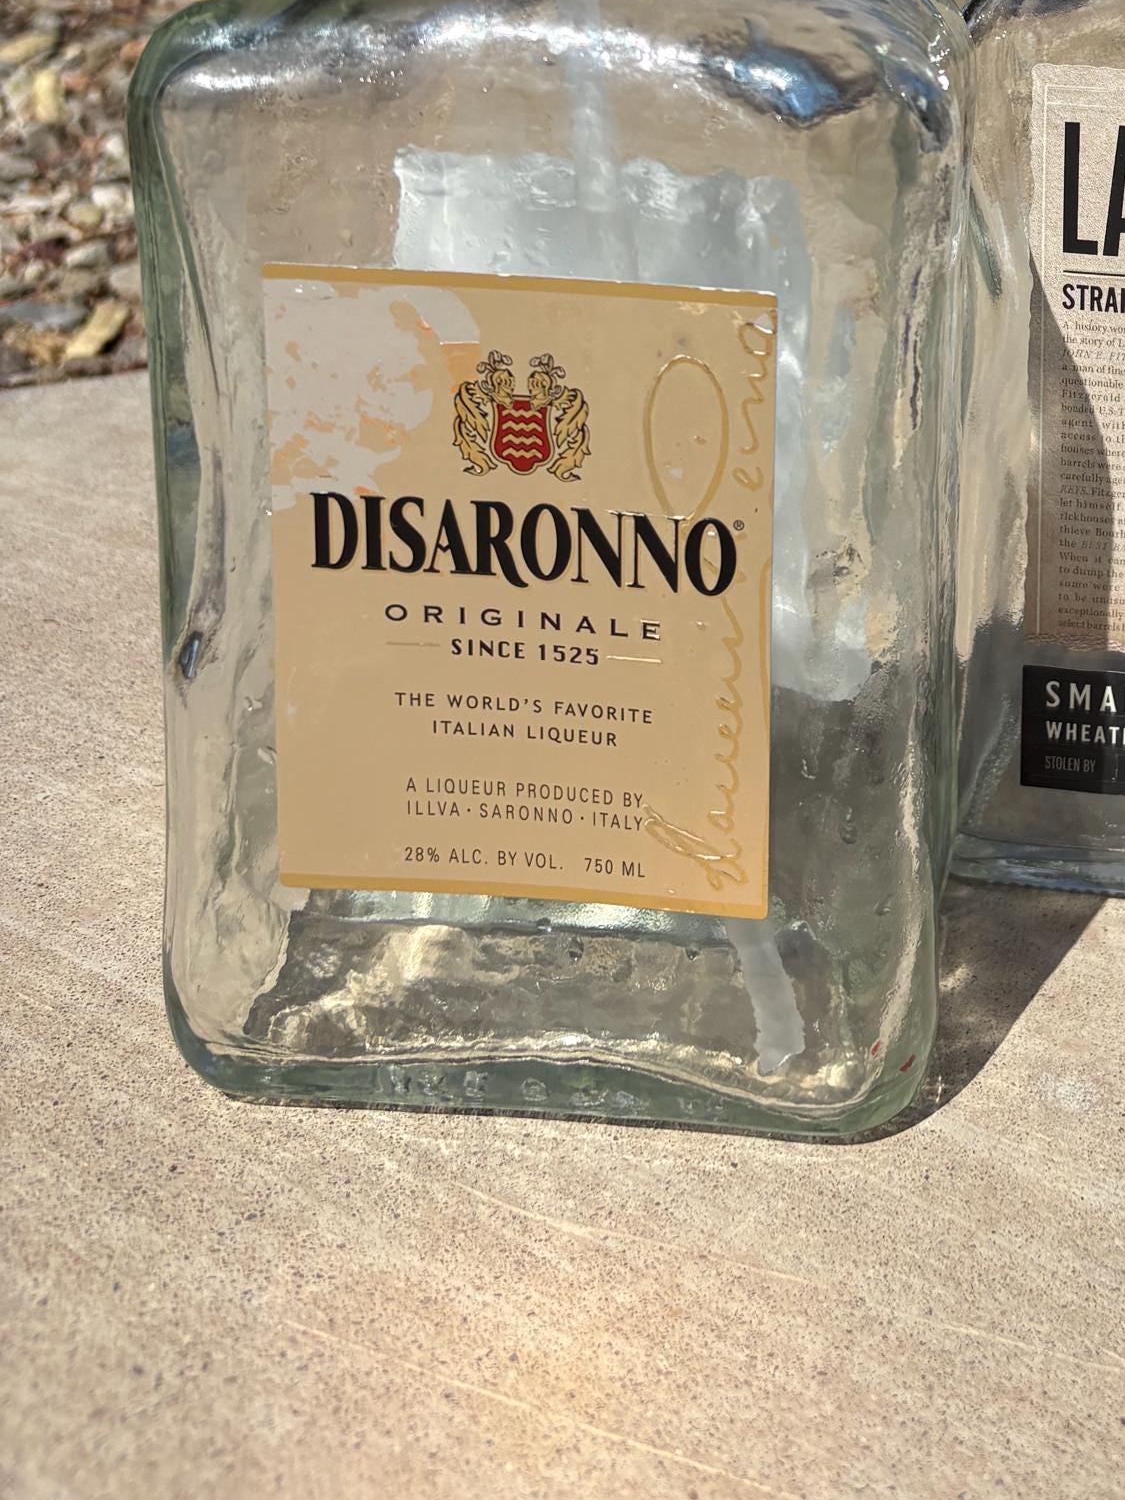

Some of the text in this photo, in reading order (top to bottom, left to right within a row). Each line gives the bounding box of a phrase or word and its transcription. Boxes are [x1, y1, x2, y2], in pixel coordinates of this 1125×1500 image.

[1080, 338, 1103, 347] story
[1106, 339, 1116, 347] of
[309, 492, 738, 597] DISARONNO
[384, 604, 662, 642] ORIGINALE
[1058, 607, 1124, 618] exceptionally
[451, 638, 599, 666] SINCE 1525
[395, 692, 653, 725] THE WORLD'S FAVORITE
[433, 720, 617, 747] ITALIAN LIQUEUR
[1045, 756, 1096, 773] STOLEN BY
[406, 777, 643, 808] A LIQUEUR PRODUCED BY
[406, 801, 643, 832] ILLVA SARONNO ITALY
[404, 847, 645, 878] 28% ALC. BY VOL. 750 ML
